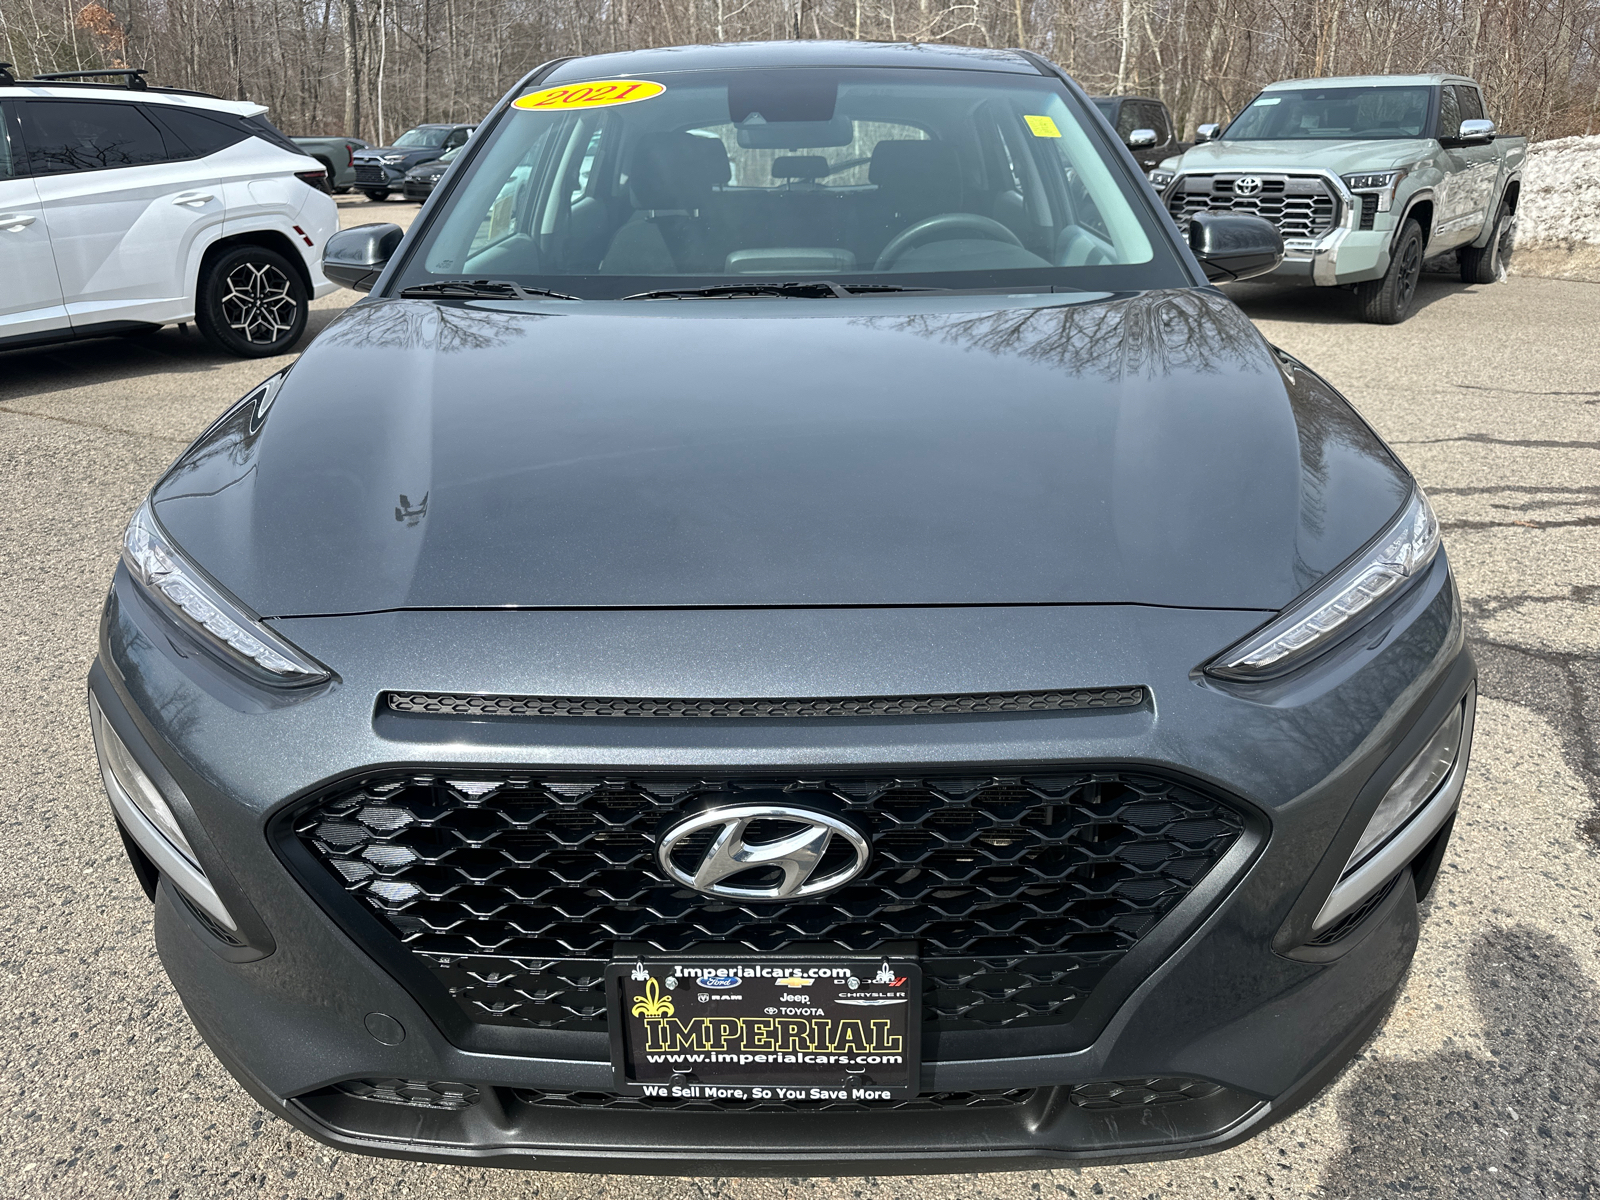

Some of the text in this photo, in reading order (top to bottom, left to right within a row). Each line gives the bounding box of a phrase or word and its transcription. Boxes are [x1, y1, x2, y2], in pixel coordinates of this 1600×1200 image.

[533, 83, 643, 107] 2021
[674, 965, 851, 980] Imperialcars.com
[706, 977, 732, 986] Ford
[779, 1007, 825, 1016] TOYOTA
[643, 1017, 903, 1053] IMPERIAL
[646, 1052, 903, 1065] www.imperialcars.com
[643, 1086, 891, 1100] We Sell More, So You Save More
